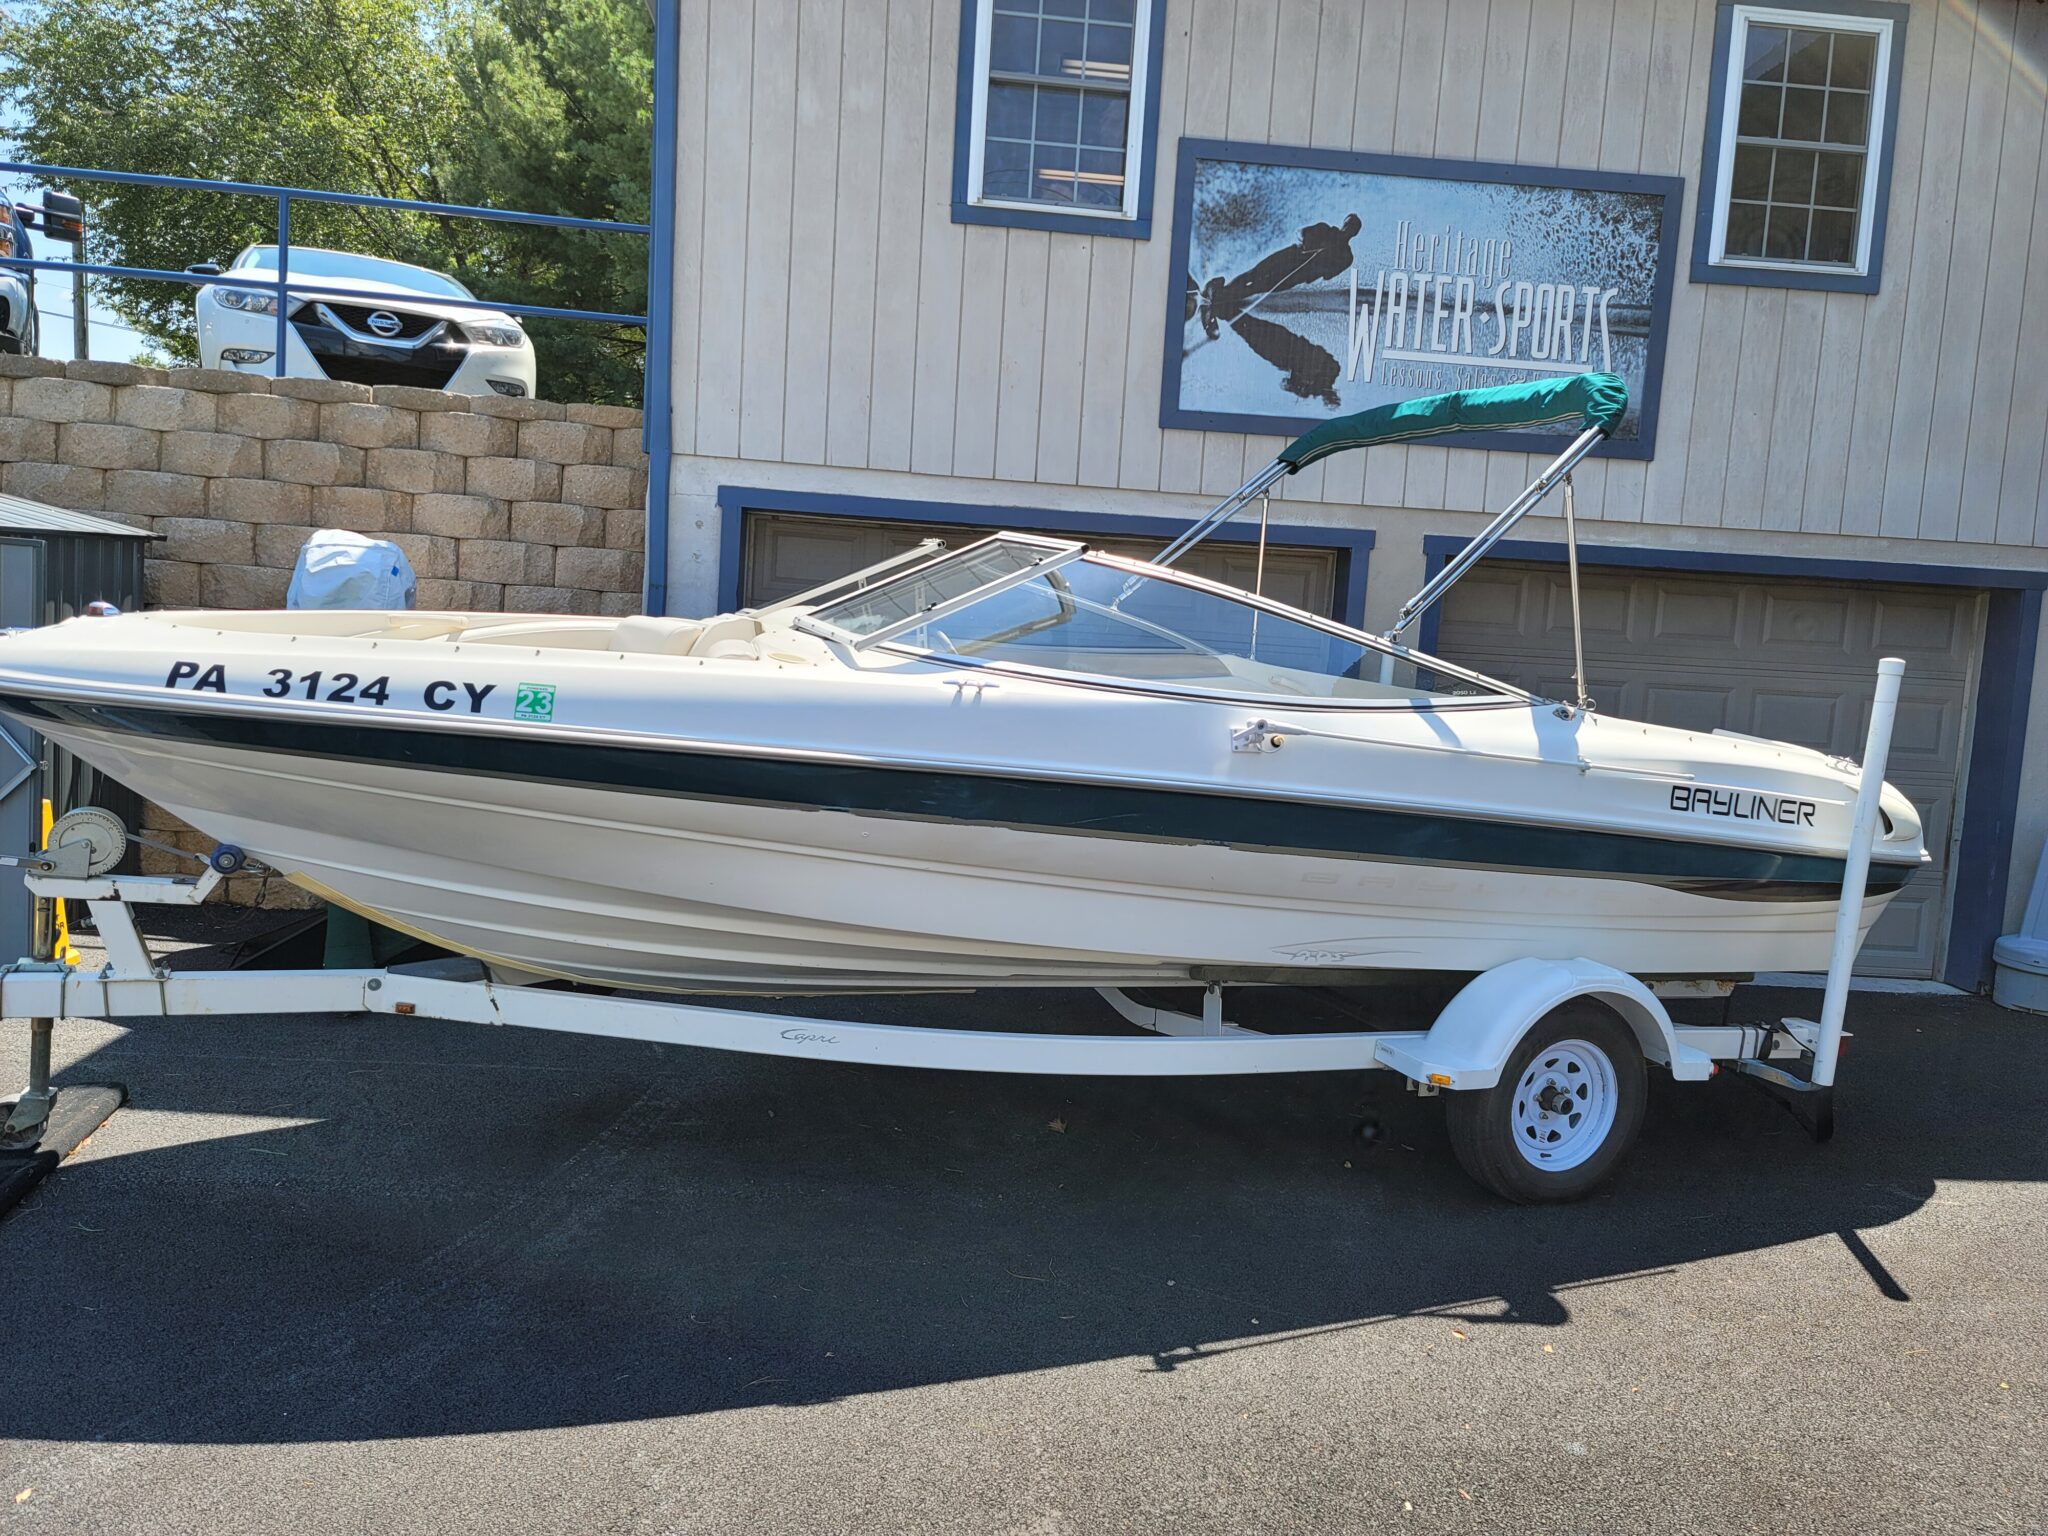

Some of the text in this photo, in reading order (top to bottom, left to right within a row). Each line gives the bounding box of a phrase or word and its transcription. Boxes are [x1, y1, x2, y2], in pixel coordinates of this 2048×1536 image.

[1394, 220, 1513, 289] Heritage
[165, 661, 497, 713] PA 3124 CY
[516, 690, 553, 714] 23
[1670, 785, 1816, 827] BAYLINER
[780, 1028, 841, 1044] Capri
